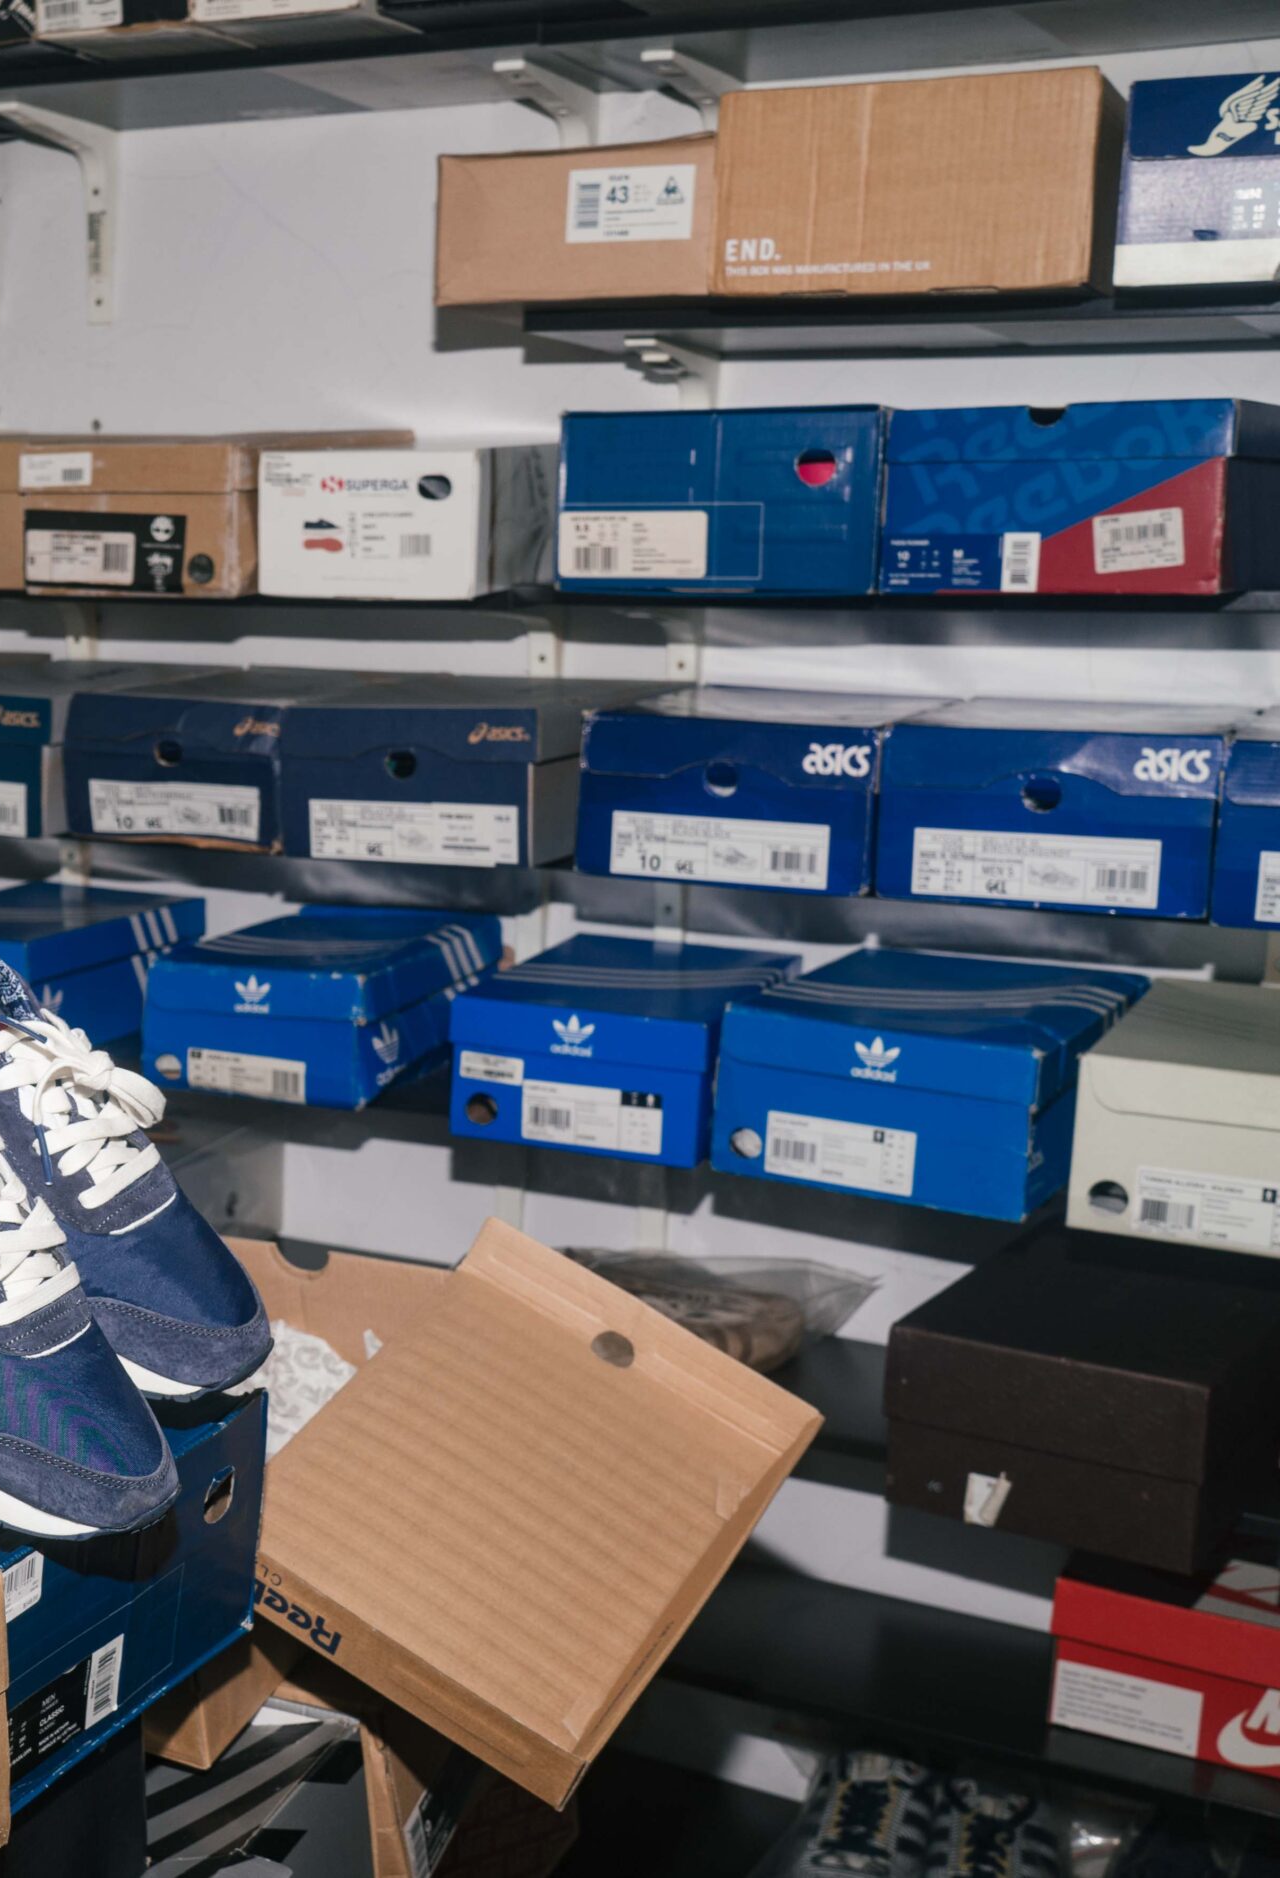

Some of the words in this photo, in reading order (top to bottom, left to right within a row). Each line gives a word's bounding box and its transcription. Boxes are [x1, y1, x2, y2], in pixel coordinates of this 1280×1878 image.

[606, 185, 629, 204] 43
[724, 238, 782, 261] END.
[345, 478, 410, 492] SUPERGA
[802, 742, 871, 778] asics
[1133, 746, 1212, 784] asics
[640, 855, 661, 872] 10
[233, 1002, 270, 1015] adidas
[549, 1043, 593, 1058] adidas
[850, 1066, 898, 1083] adidas
